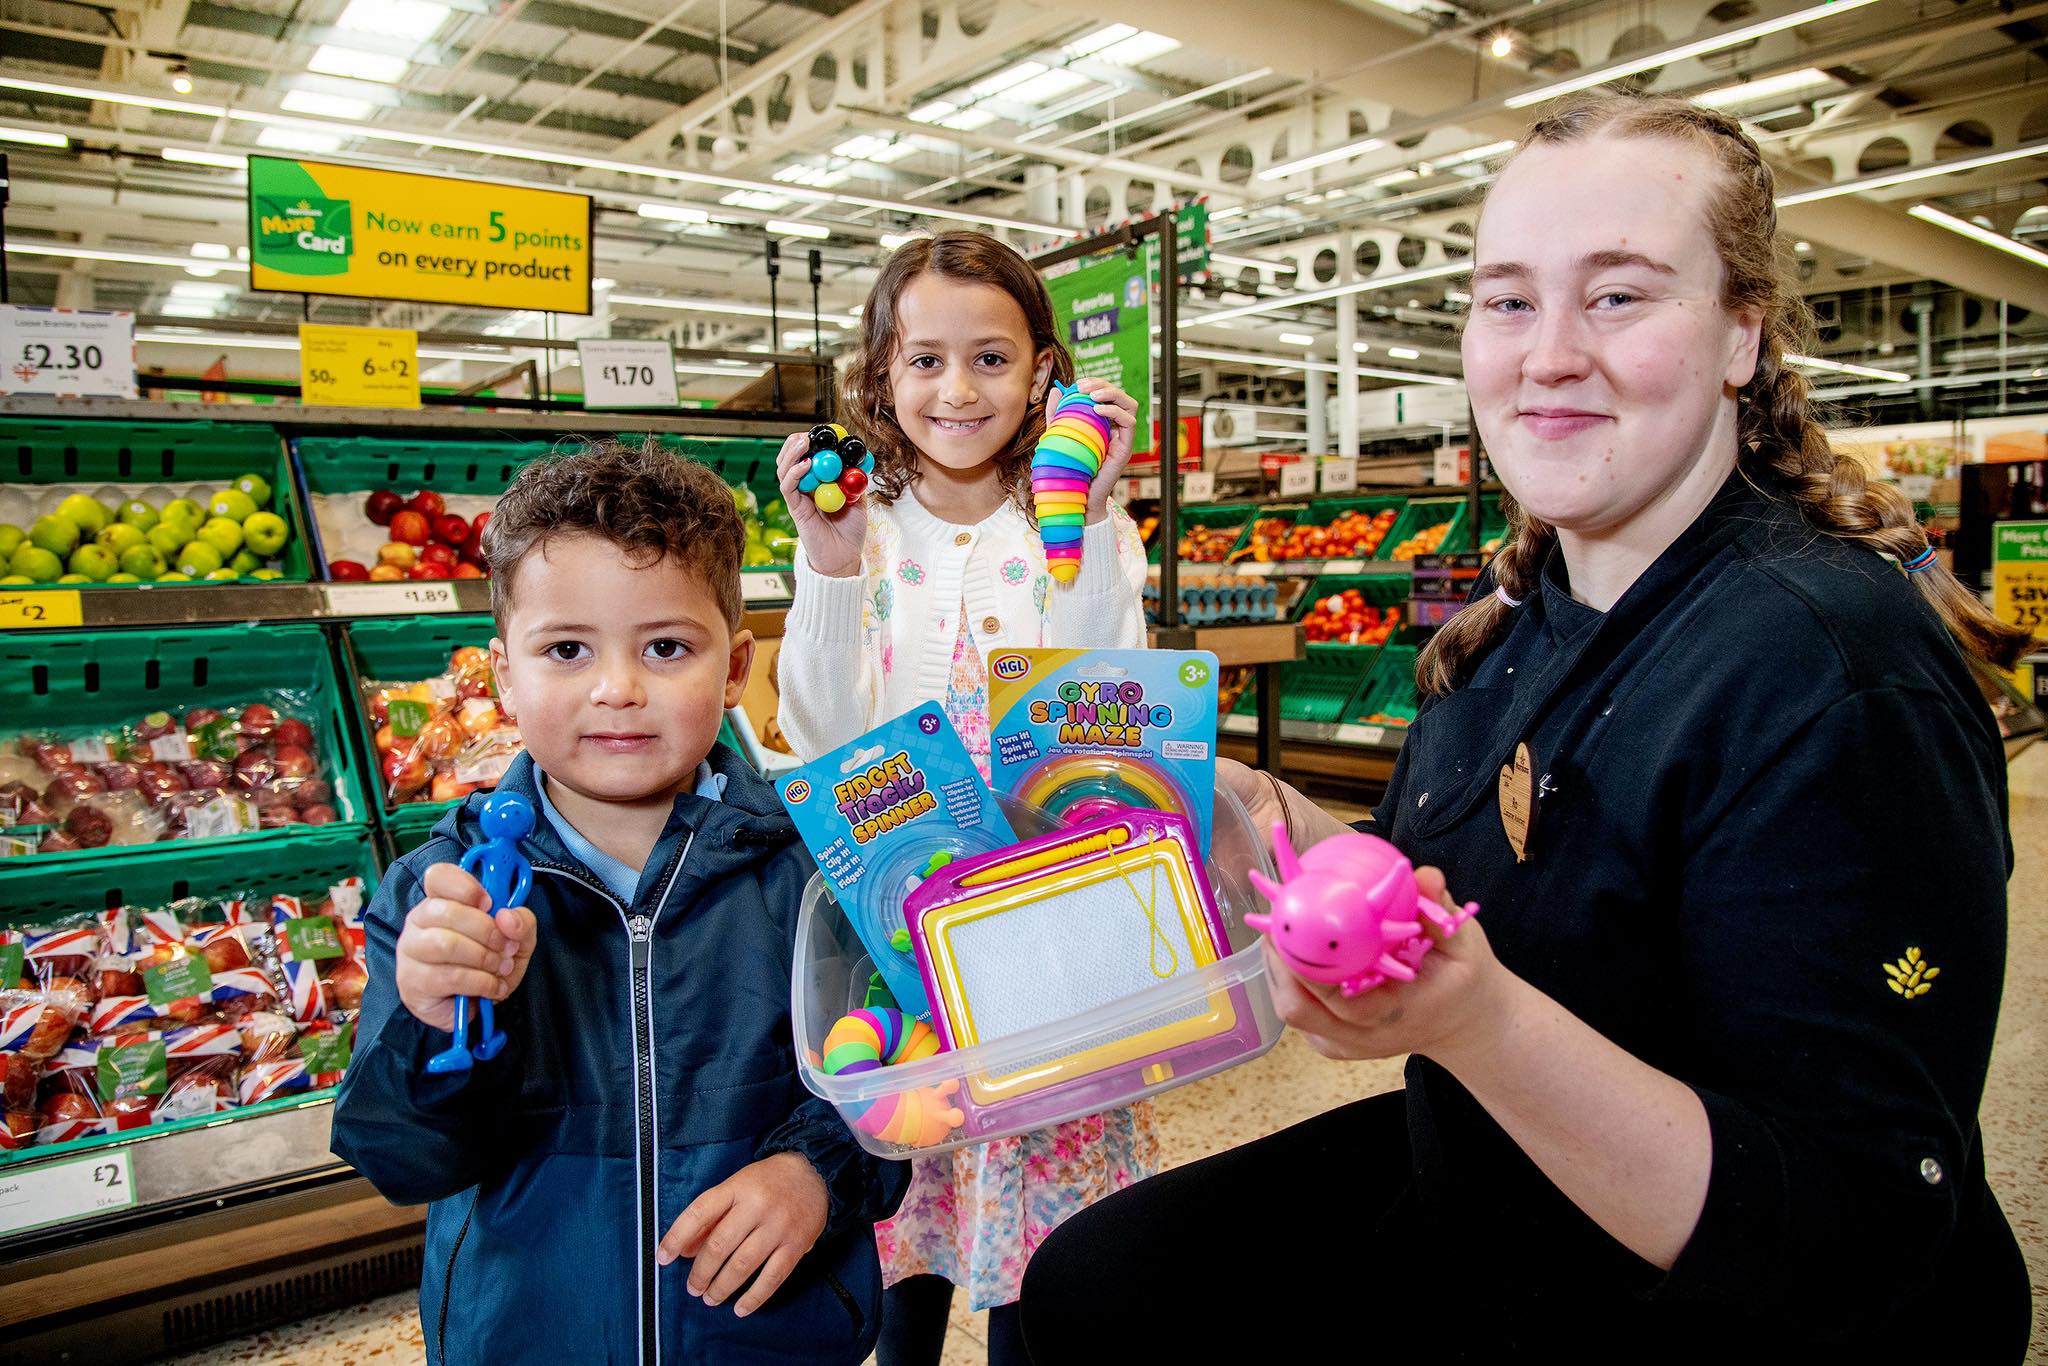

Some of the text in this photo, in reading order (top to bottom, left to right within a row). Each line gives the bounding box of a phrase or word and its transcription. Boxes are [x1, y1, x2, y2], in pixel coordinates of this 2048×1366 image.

[261, 215, 315, 235] More
[367, 211, 582, 250] Now earn 5 points
[297, 231, 345, 254] Card
[378, 250, 572, 280] on every product
[24, 344, 102, 369] £2.30
[363, 359, 375, 376] 6
[391, 359, 409, 377] £2
[603, 366, 654, 385] £1.70
[405, 590, 449, 602] £1.89
[23, 605, 48, 620] £2
[998, 660, 1025, 674] HGL
[1185, 665, 1207, 682] 3+
[1058, 681, 1143, 704] GYRO
[1030, 701, 1172, 727] SPINNING
[921, 717, 938, 732] 3+
[997, 731, 1030, 746] Turn it!
[1059, 724, 1142, 746] MAZE
[1002, 740, 1034, 755] Spin it!
[1074, 748, 1106, 756] rotation
[1113, 749, 1153, 760] Spinnspiel
[1002, 749, 1039, 765] Solve it!
[834, 752, 913, 804] FIDGET
[788, 784, 807, 799] HGL
[838, 771, 925, 825] Tracks
[853, 792, 937, 845] SPINNER
[816, 846, 836, 862] Spin
[825, 855, 842, 869] Clip
[830, 861, 852, 879] Twist
[838, 865, 866, 889] Fidget!
[93, 1163, 122, 1188] £2
